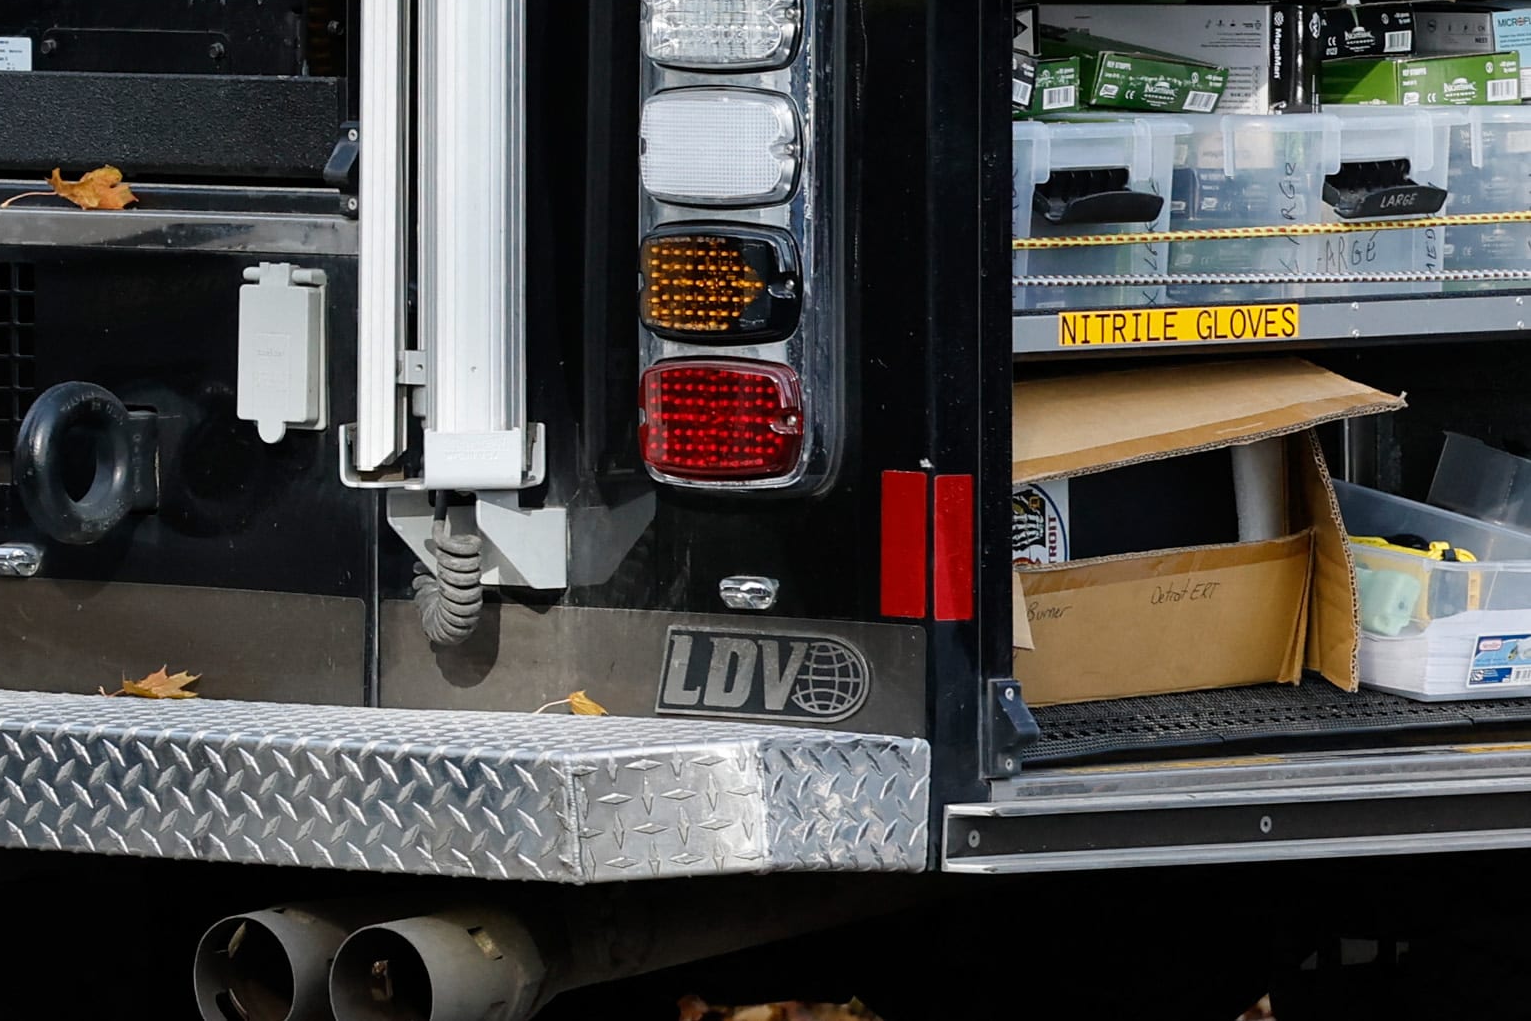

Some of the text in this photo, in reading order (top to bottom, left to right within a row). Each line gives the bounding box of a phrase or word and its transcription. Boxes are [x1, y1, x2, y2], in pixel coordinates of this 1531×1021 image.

[1379, 193, 1417, 209] LARGE
[1317, 230, 1380, 274] ARGE
[1060, 307, 1296, 344] NITRILE GLOVES
[662, 633, 810, 712] LDV
